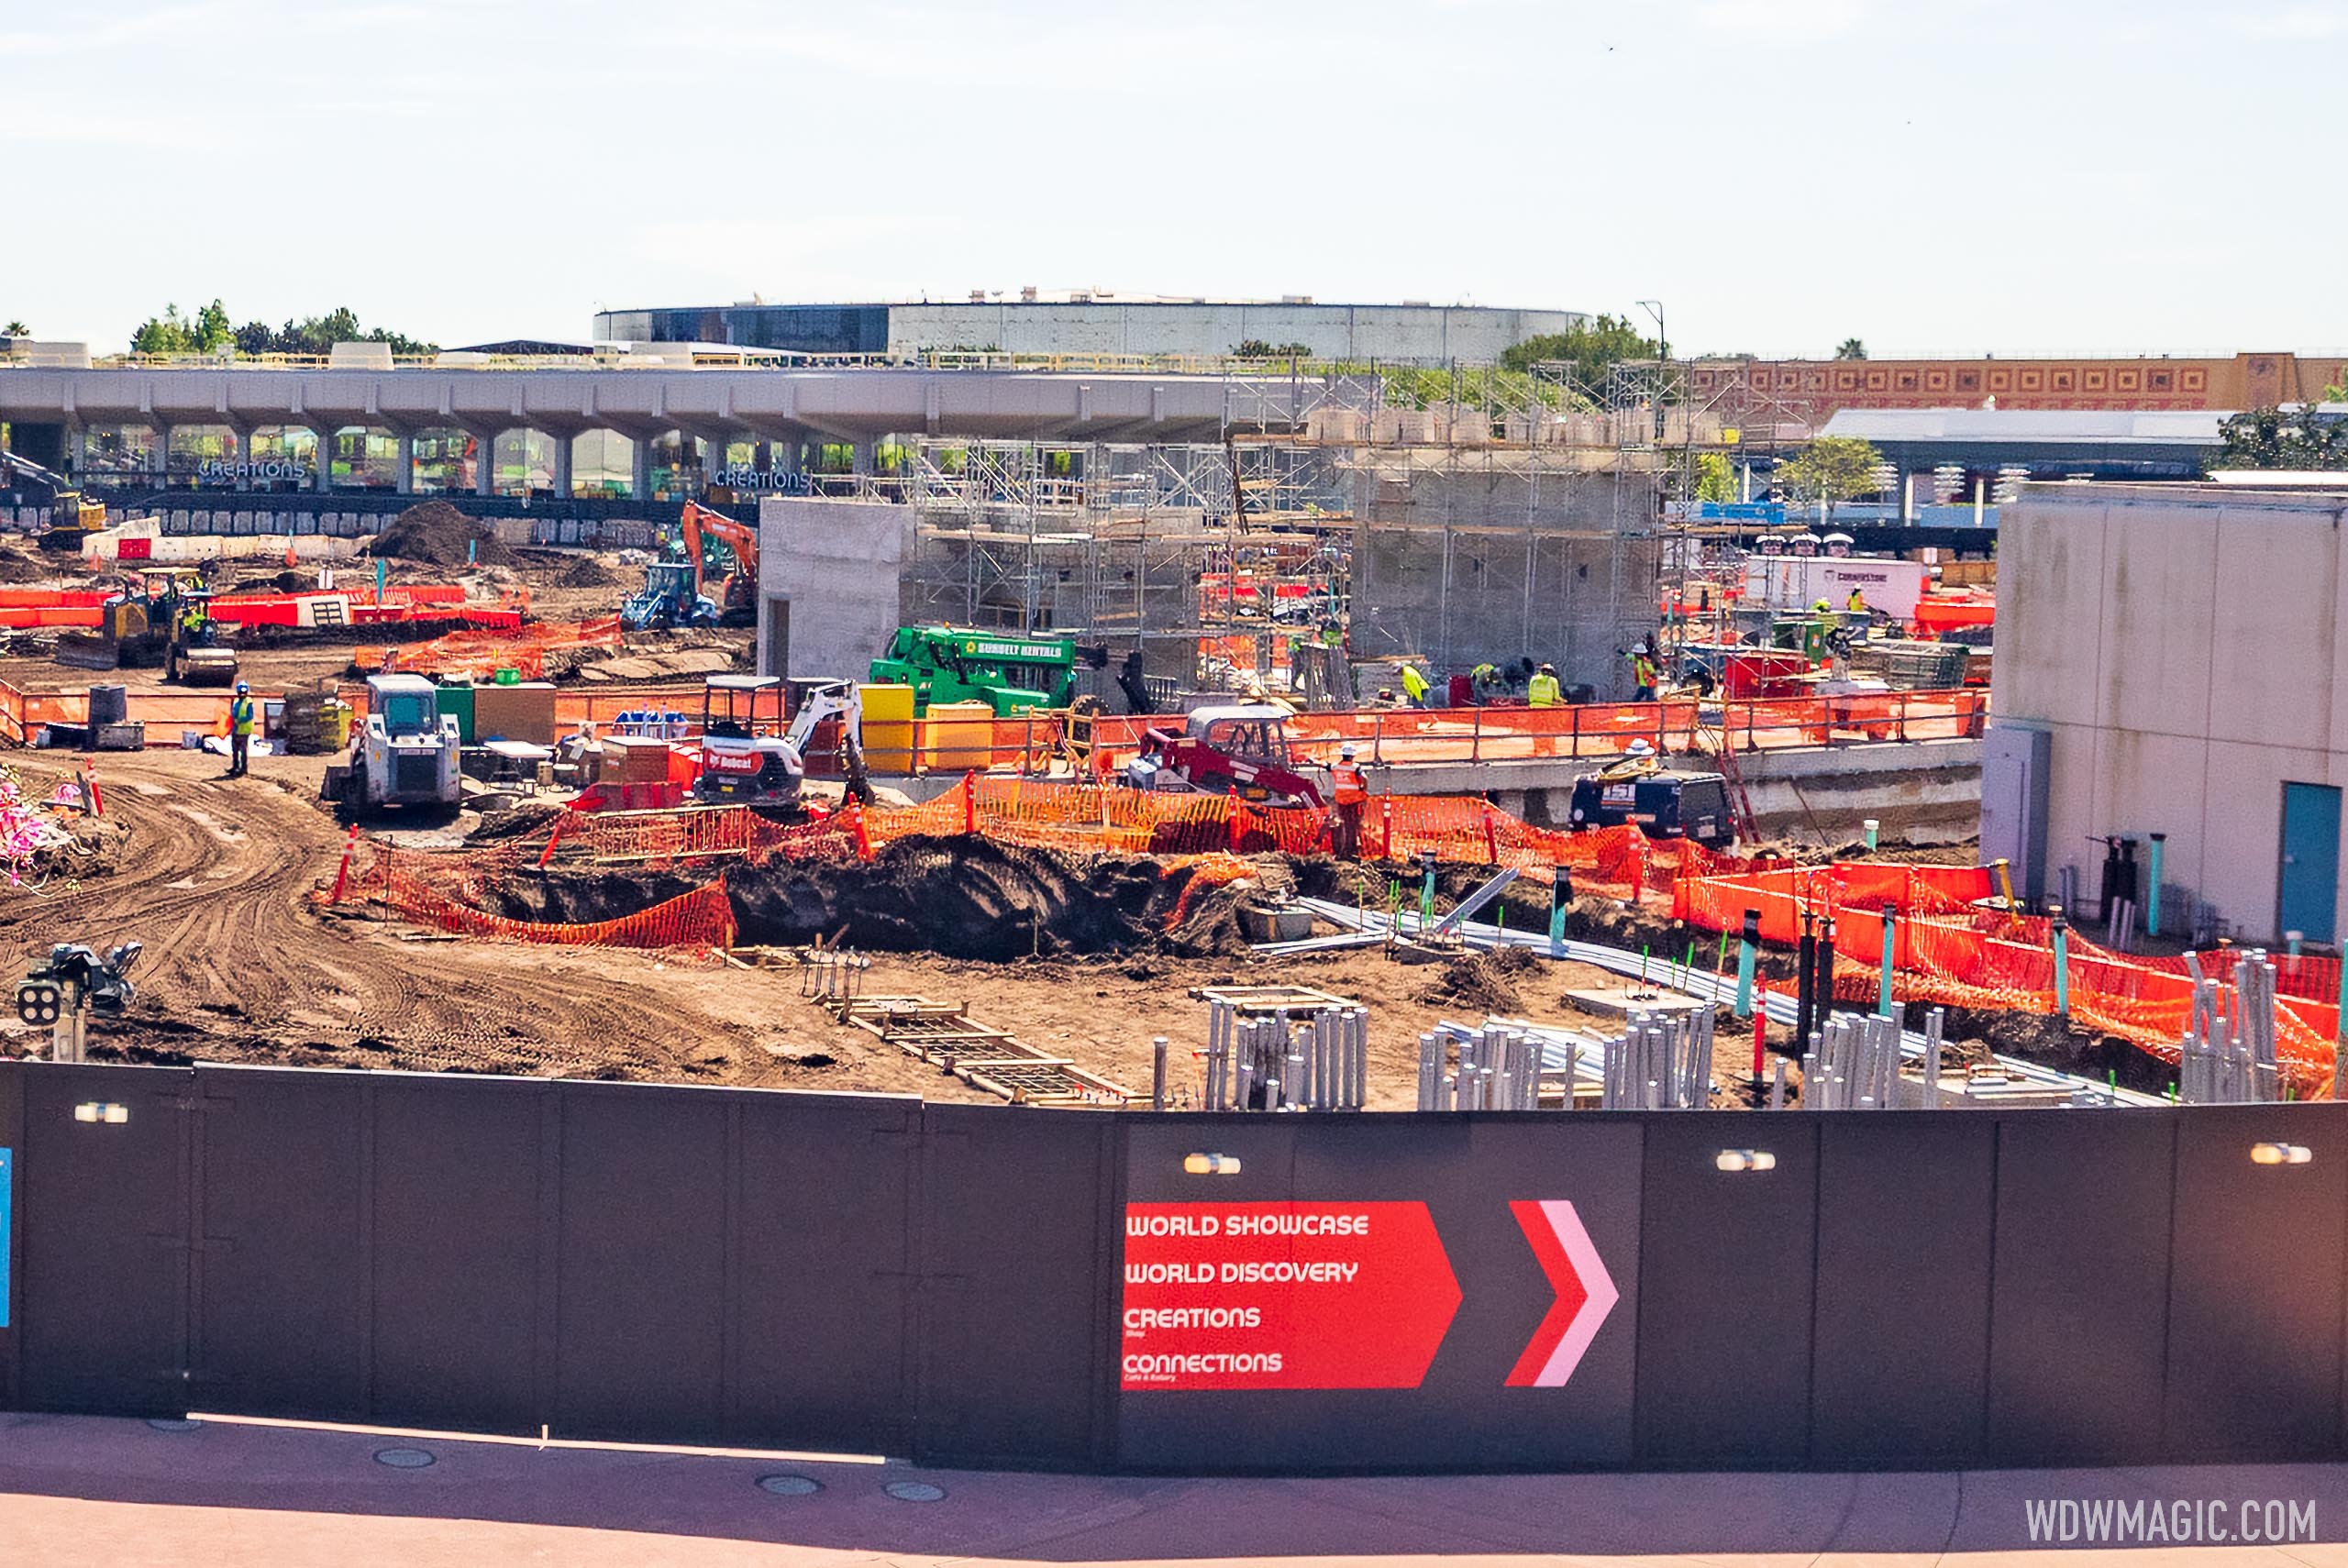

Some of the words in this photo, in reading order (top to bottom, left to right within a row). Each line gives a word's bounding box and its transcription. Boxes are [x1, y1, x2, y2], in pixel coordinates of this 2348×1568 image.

[198, 460, 305, 477] CREATIONS
[715, 469, 810, 488] CREATIONS
[1126, 1216, 1219, 1236] WORLD
[1225, 1215, 1368, 1235] SHOWCASE
[1124, 1263, 1215, 1284] WORLD
[1221, 1262, 1358, 1283] DISCOVERY
[1124, 1307, 1261, 1329] CREATIONS
[1123, 1353, 1282, 1374] CONNECTIONS
